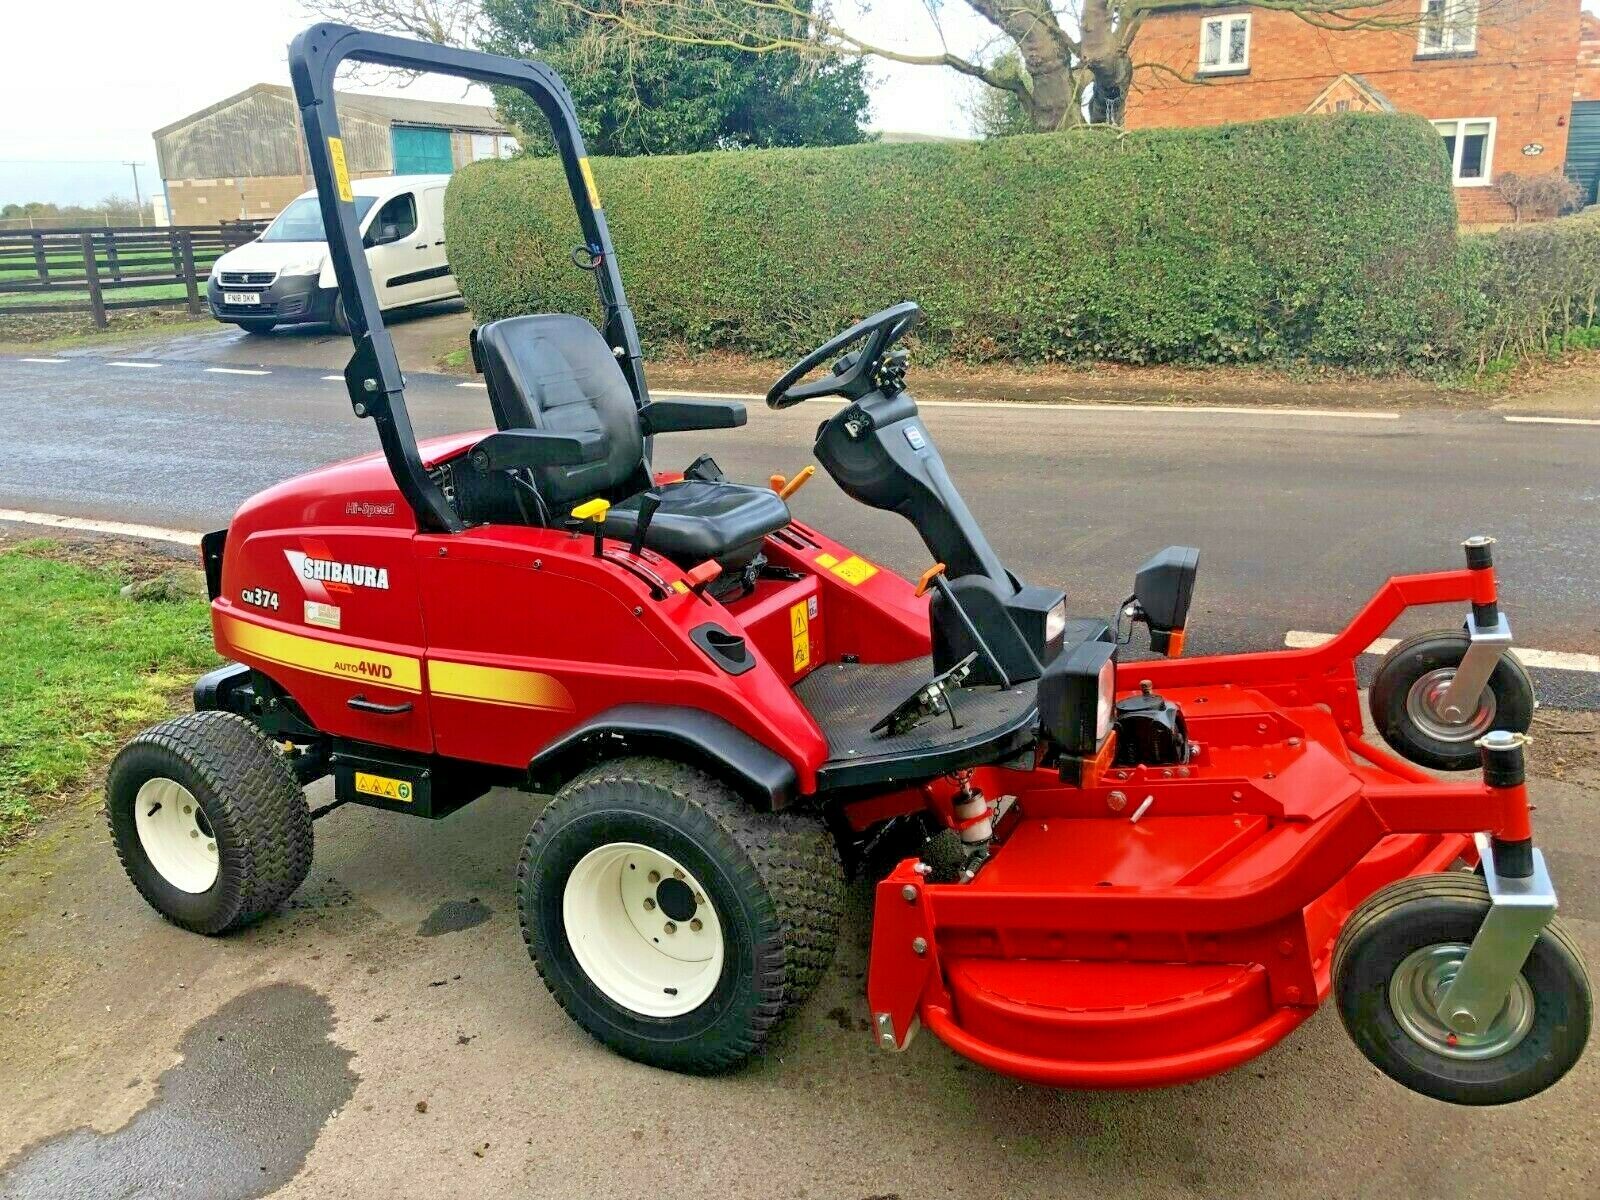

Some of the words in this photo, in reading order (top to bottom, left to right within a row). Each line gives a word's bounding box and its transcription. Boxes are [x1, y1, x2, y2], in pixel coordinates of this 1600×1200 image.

[242, 294, 256, 303] DKK
[345, 501, 395, 517] Hi-Speed
[304, 557, 389, 590] SHIBAURA
[241, 587, 279, 610] CM374
